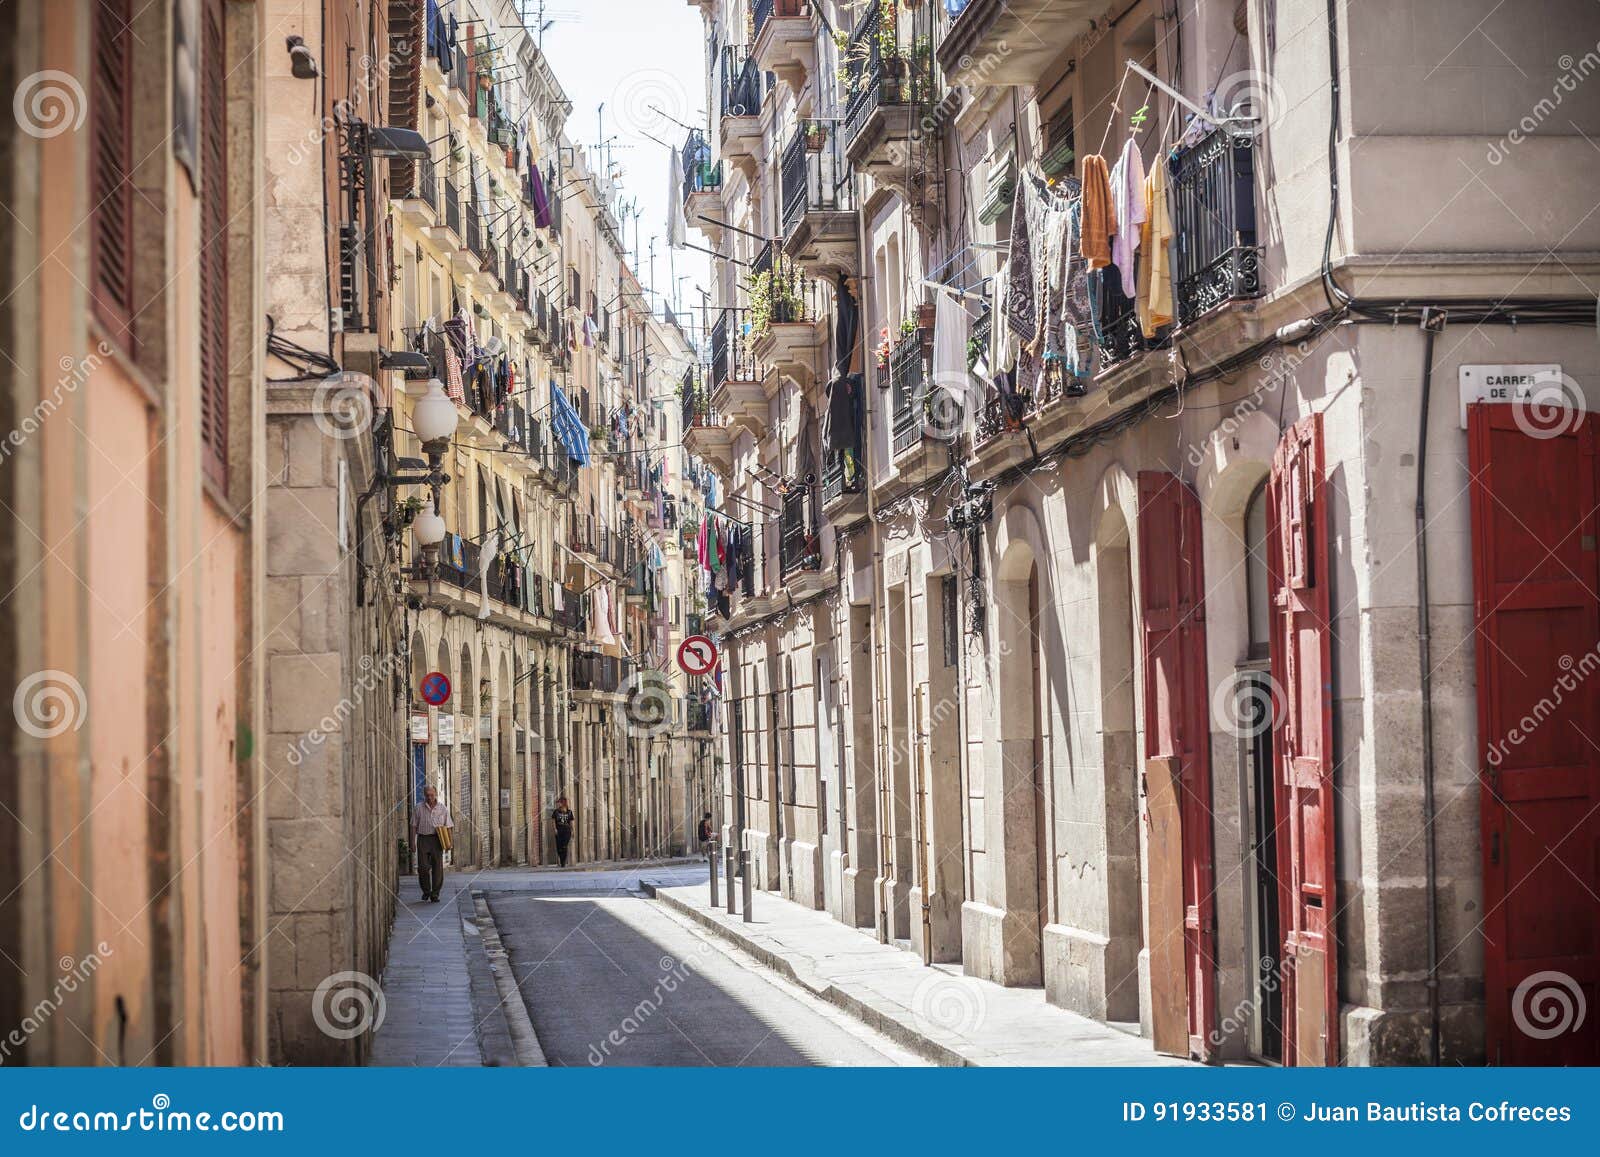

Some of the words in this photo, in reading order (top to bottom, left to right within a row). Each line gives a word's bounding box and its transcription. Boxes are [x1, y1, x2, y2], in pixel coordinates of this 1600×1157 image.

[1486, 375, 1536, 386] CARRER
[1490, 388, 1507, 399] DE
[1515, 388, 1532, 399] LA
